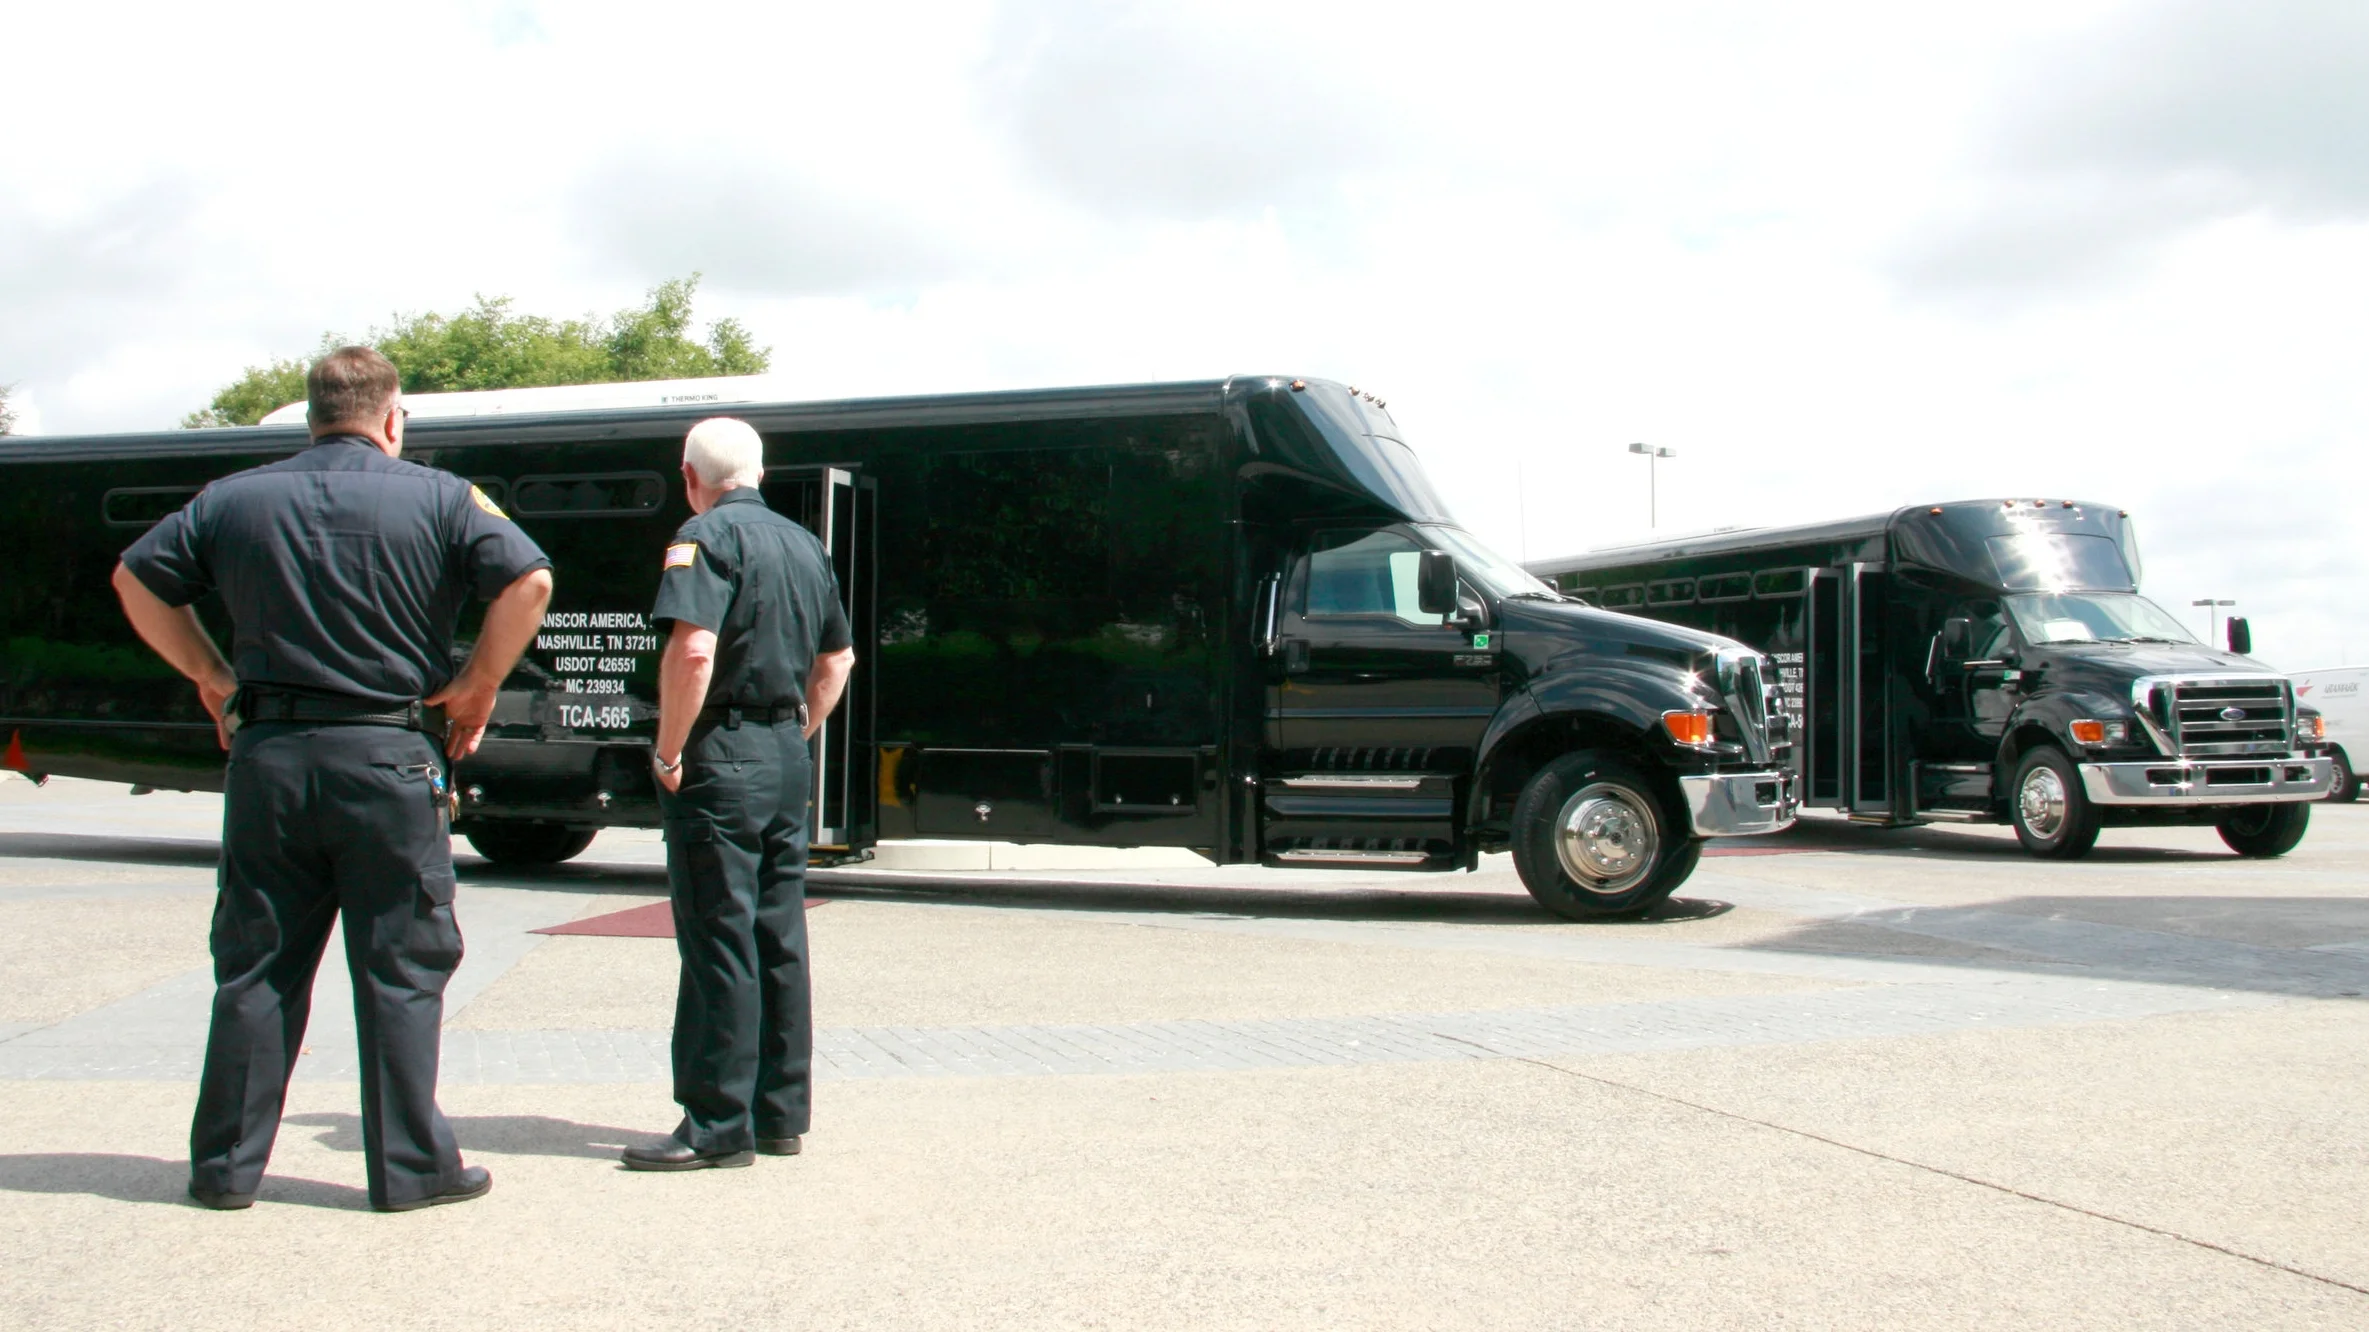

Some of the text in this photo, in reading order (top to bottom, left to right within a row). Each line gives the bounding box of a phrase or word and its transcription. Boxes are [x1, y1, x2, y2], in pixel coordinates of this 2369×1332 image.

[541, 612, 588, 628] ANSCOR
[589, 612, 647, 630] AMERICA,
[537, 634, 657, 652] NASHVILLE, TN 37211
[556, 657, 636, 672] USDOT 426551
[566, 679, 625, 694] MC 239934
[559, 705, 630, 728] TCA-565
